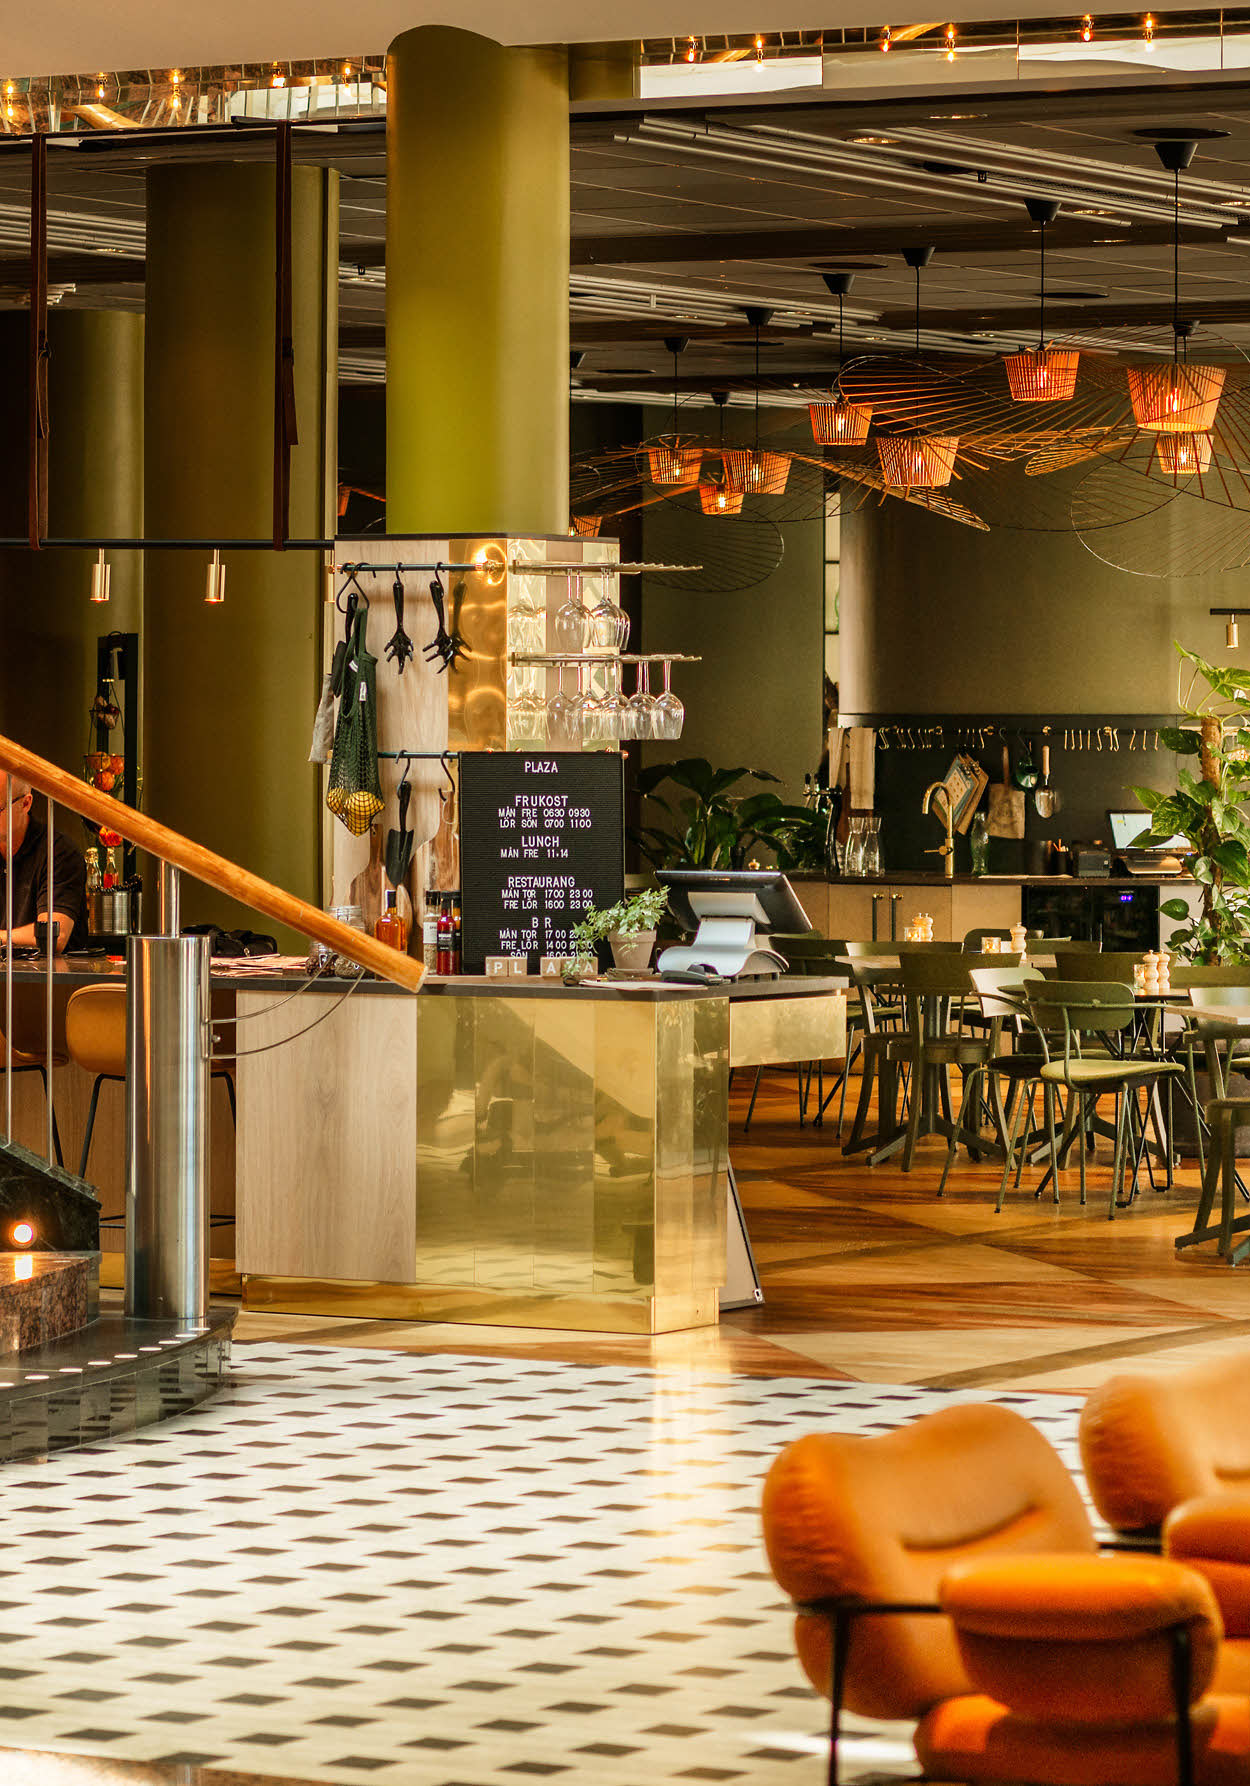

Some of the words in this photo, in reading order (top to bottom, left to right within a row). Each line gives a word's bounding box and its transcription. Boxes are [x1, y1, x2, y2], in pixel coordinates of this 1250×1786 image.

[524, 761, 559, 773] PLAZA
[515, 795, 569, 807] FRUKOST
[498, 806, 516, 818] MÅN
[521, 808, 538, 818] FRE
[543, 808, 565, 818] 0630
[568, 808, 591, 818] 0930
[499, 816, 516, 829] LÖR
[521, 816, 538, 829] SÖN
[544, 819, 565, 829] 0700
[570, 819, 592, 829] 1100
[521, 836, 560, 847] LUNCH
[500, 846, 519, 858] MÅN
[523, 848, 539, 858] FRE
[508, 876, 575, 888] RESTAURANG
[501, 887, 520, 899] MÅN
[522, 889, 537, 899] TOR
[503, 900, 519, 910] FRE
[521, 898, 538, 910] LÖR
[499, 927, 518, 939] MÅN
[520, 930, 537, 939] TOR
[500, 941, 517, 950] FRE
